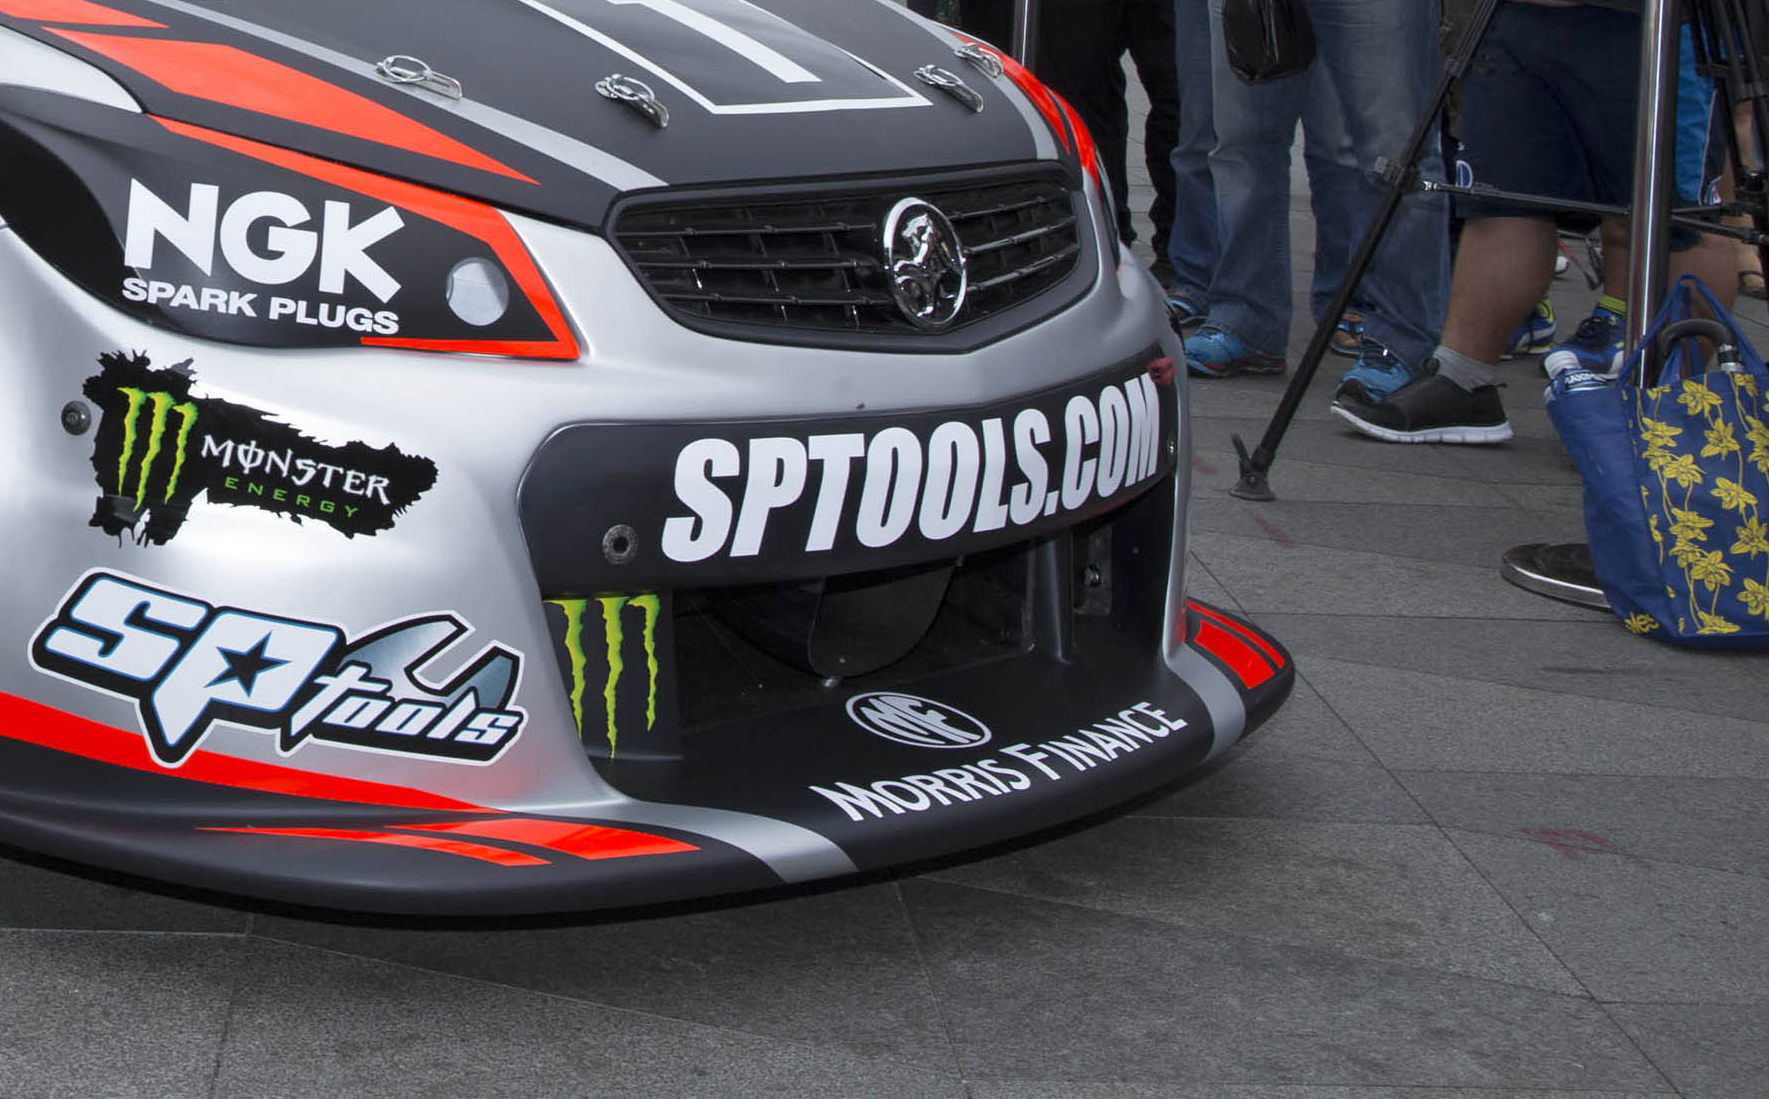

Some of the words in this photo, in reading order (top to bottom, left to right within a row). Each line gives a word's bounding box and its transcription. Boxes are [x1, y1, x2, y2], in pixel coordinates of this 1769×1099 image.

[123, 177, 405, 303] NGK
[122, 277, 257, 317] SPARK
[268, 297, 401, 335] PLUGS
[224, 477, 359, 518] ENERGY
[661, 372, 1163, 563] SPTOOLS.COM
[45, 575, 340, 747] SP
[810, 756, 1034, 823] MORRIS
[1017, 700, 1190, 783] FINANCE
